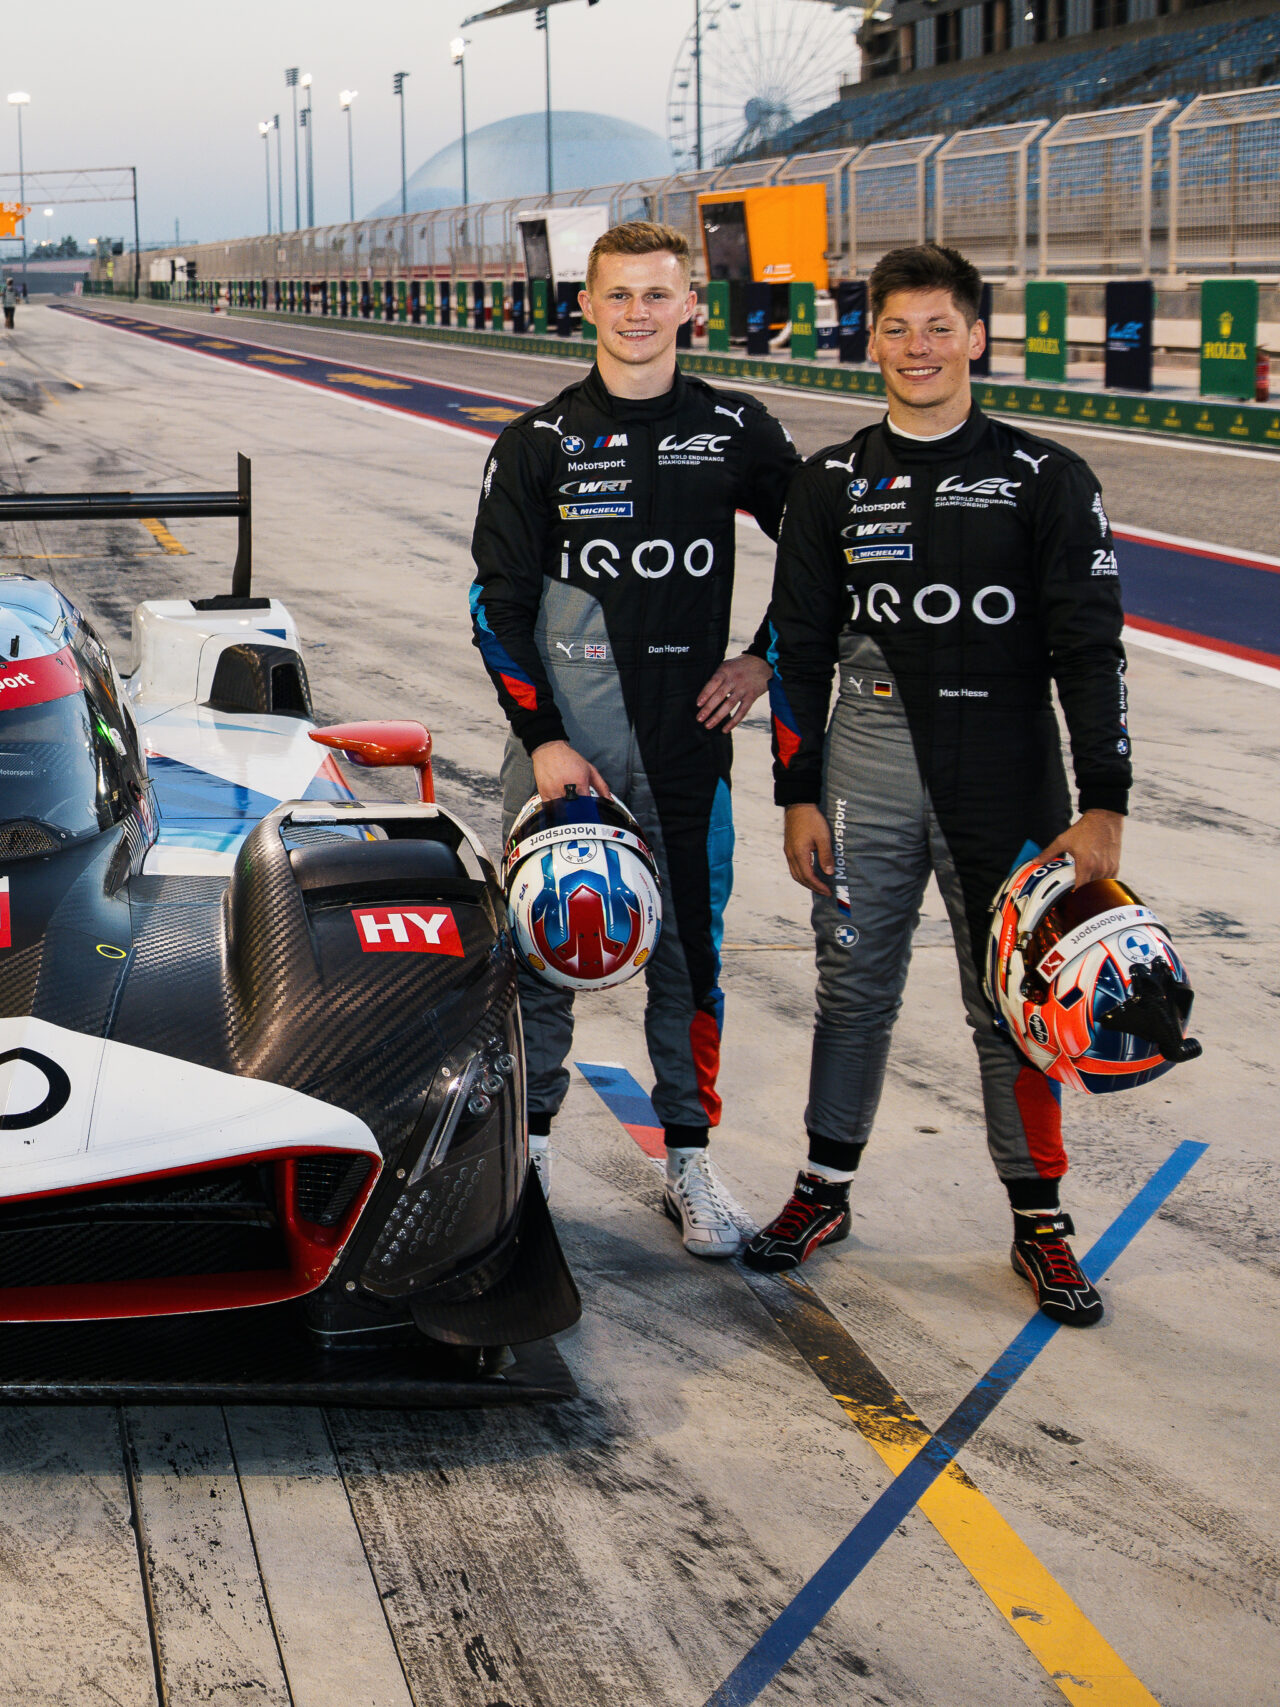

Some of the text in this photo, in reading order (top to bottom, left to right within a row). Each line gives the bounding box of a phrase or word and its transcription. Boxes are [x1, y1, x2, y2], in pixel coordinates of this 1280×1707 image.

[1026, 336, 1060, 355] ROLEX
[1203, 342, 1247, 360] ROLEX
[658, 434, 732, 453] WEC
[568, 459, 626, 472] Motorsport
[578, 479, 632, 493] WRT
[936, 475, 1021, 498] WEC
[580, 506, 626, 515] MICHELIN
[856, 522, 912, 536] WRT
[561, 539, 714, 579] iQOO
[860, 549, 905, 558] MICHELIN
[846, 582, 1016, 625] iQOO
[648, 644, 690, 655] Dan Harper
[939, 688, 989, 698] Max Hesse
[530, 826, 597, 847] Motorsport
[835, 798, 848, 880] Motorsport
[359, 913, 448, 945] HY
[1070, 912, 1127, 945] Motorsport
